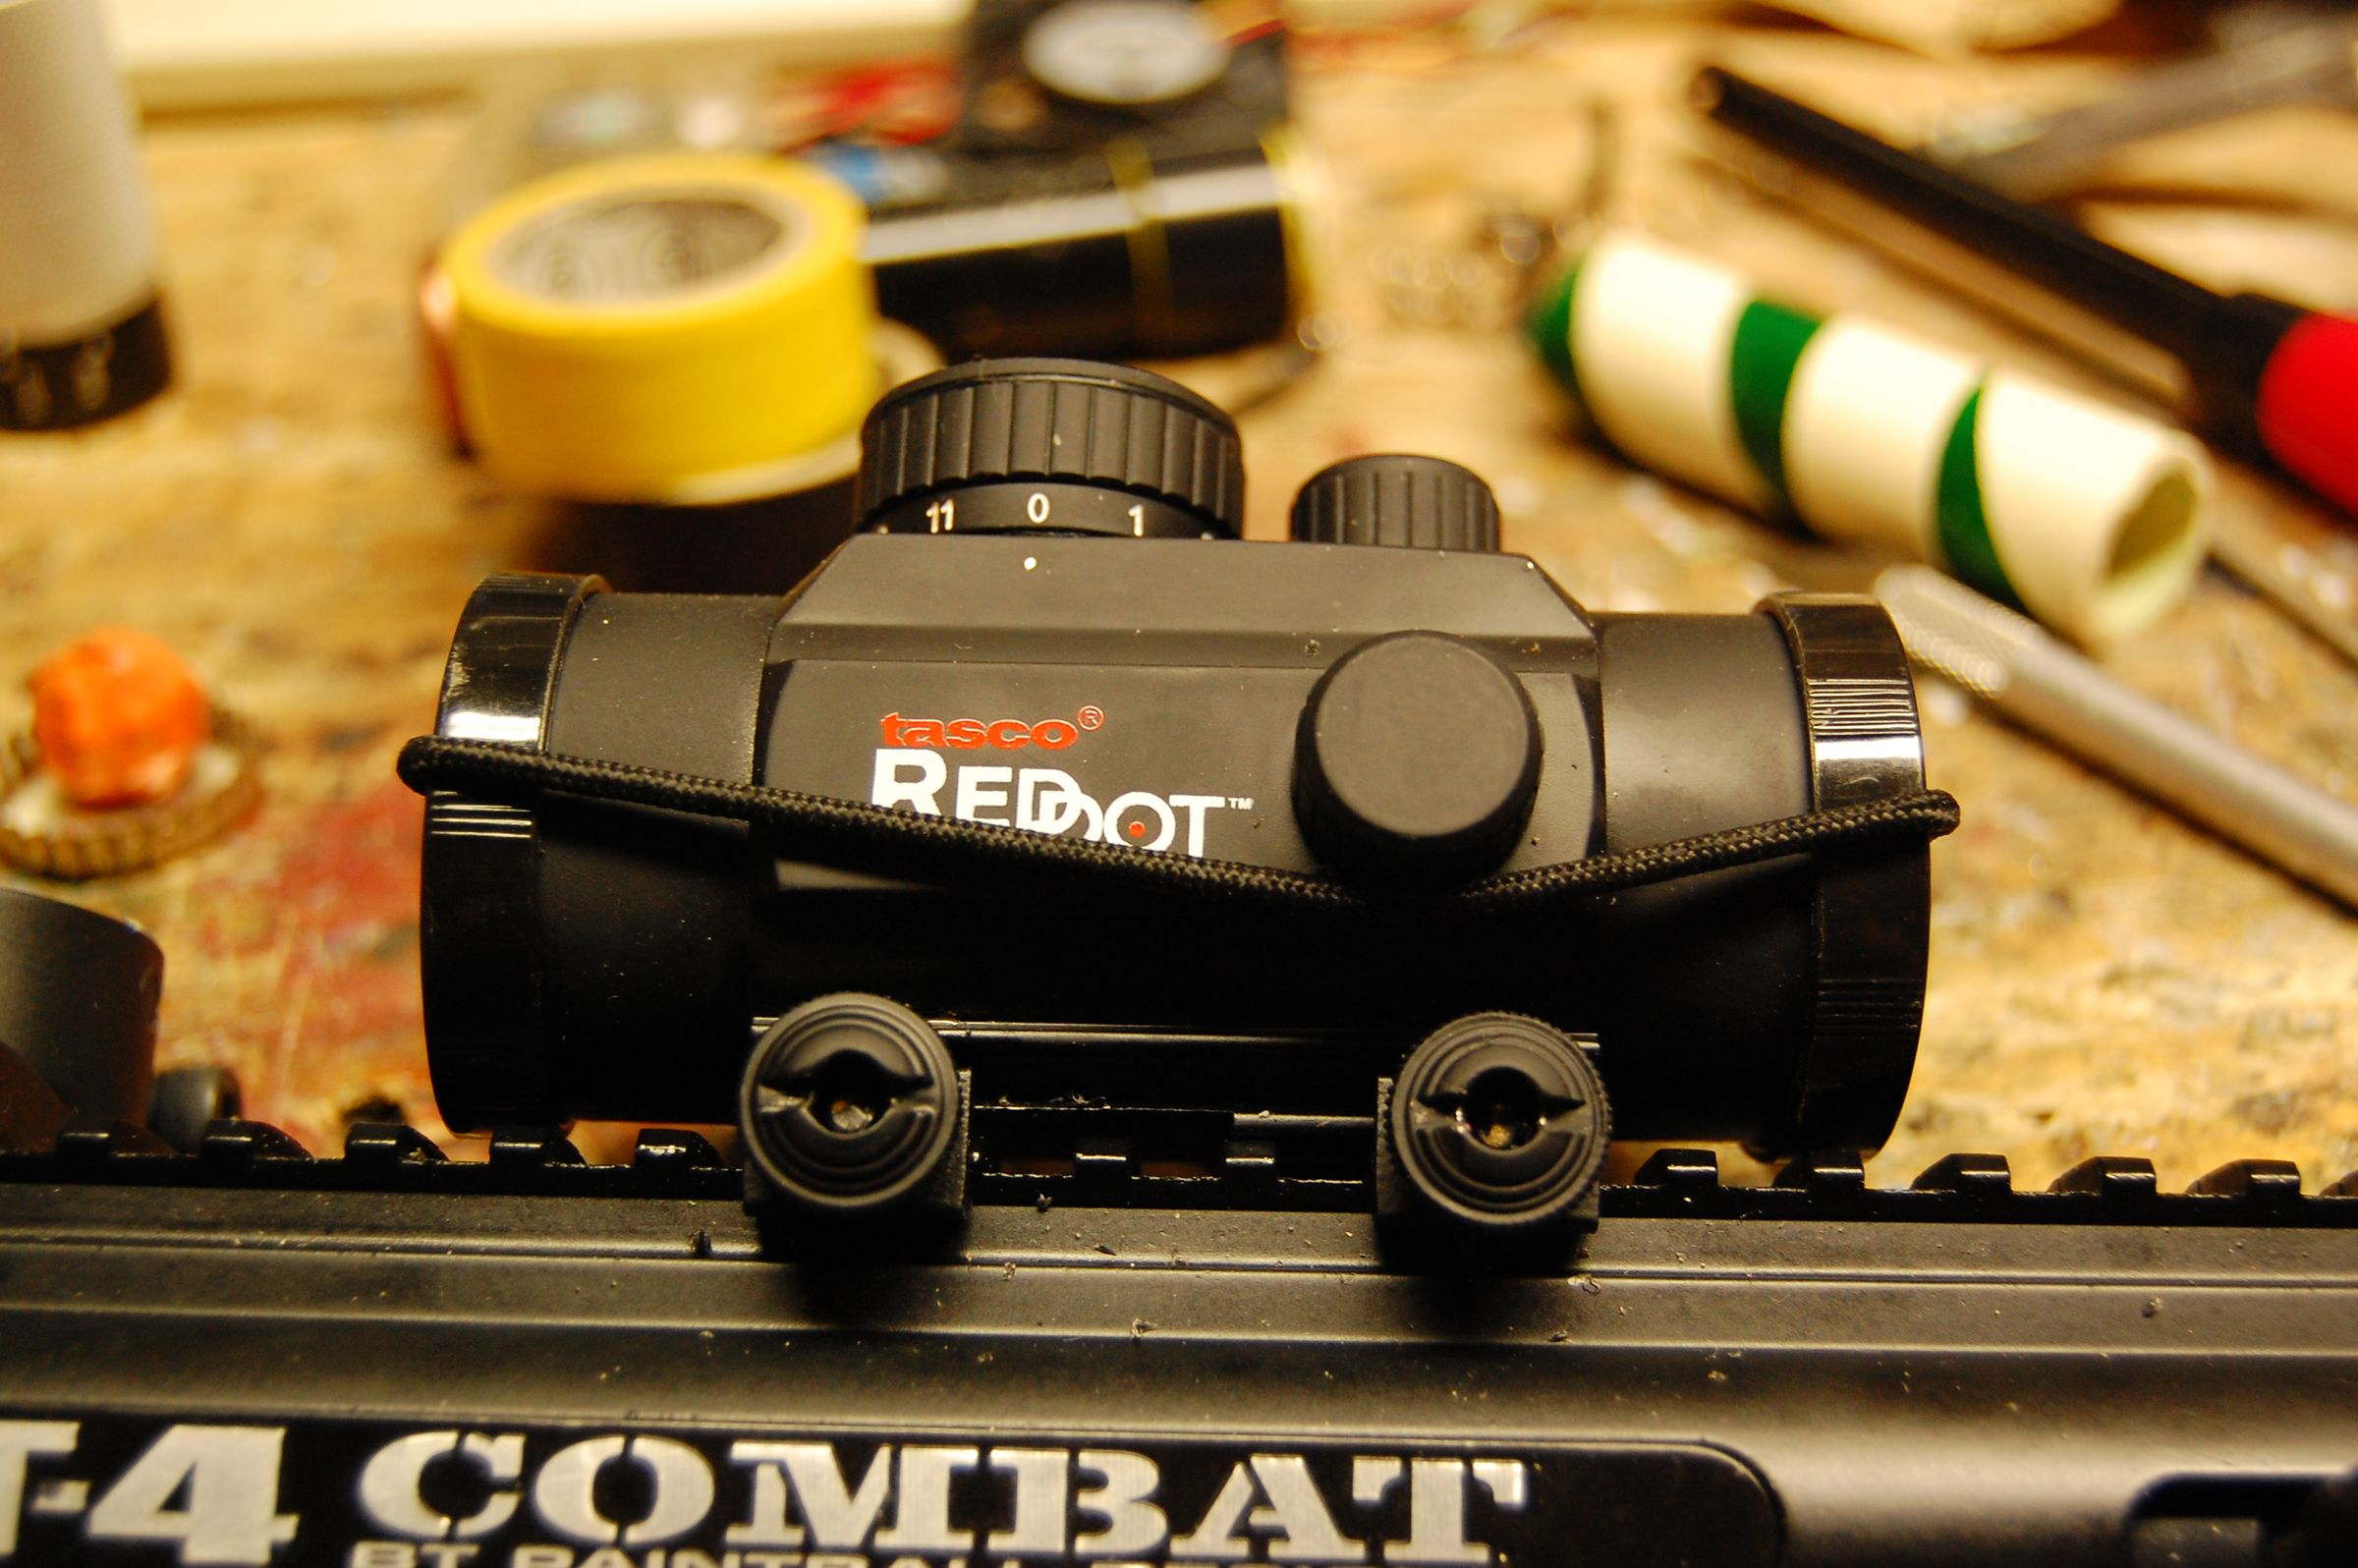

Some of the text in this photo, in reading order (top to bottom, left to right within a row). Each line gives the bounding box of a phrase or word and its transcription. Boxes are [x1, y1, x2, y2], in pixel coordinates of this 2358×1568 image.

[926, 491, 1146, 537] 11 0 1
[358, 1430, 1527, 1563] COMBAT
[351, 1540, 480, 1568] BT
